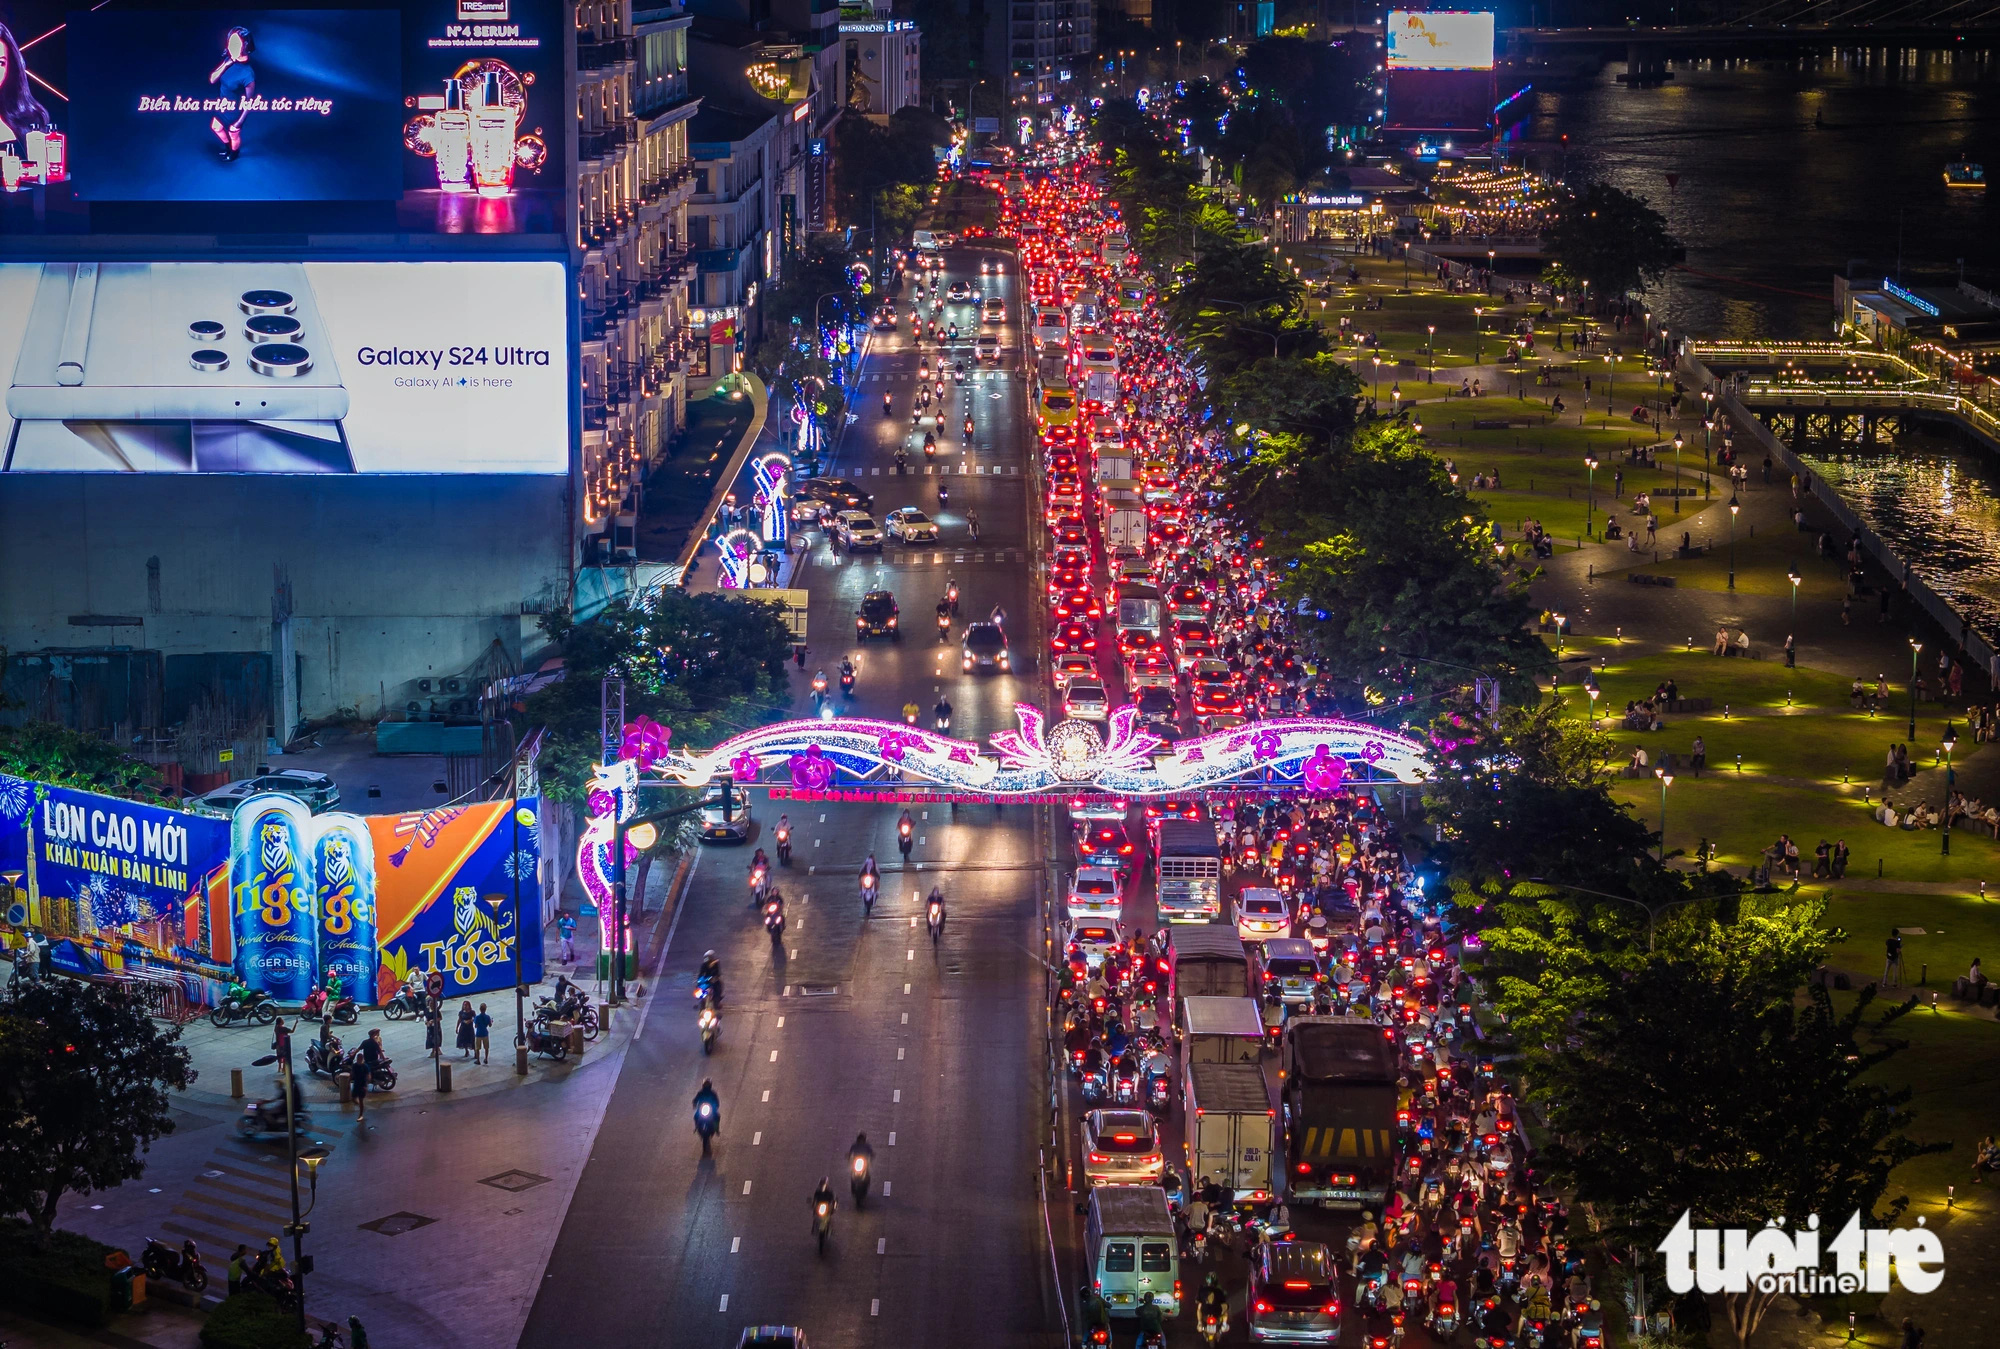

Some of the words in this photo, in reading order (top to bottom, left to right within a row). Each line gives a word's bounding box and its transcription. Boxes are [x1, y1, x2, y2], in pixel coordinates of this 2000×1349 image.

[461, 2, 505, 11] TRESemmé
[473, 25, 519, 37] SERUM
[138, 95, 171, 111] Biến
[173, 95, 200, 111] hóa
[203, 97, 236, 113] triệu
[239, 94, 268, 111] kiểu
[271, 97, 293, 111] tóc
[294, 97, 332, 115] riêng
[357, 346, 444, 370] Galaxy
[448, 346, 489, 366] S24
[494, 346, 550, 366] Ultra
[394, 377, 440, 389] Galaxy
[442, 377, 454, 387] AI
[469, 377, 480, 387] is
[482, 376, 513, 387] here
[843, 788, 875, 802] NĂM
[1027, 792, 1061, 804] NAM
[43, 800, 86, 843] LON
[91, 809, 137, 854] CAO
[142, 816, 188, 865] MỚI
[45, 842, 78, 867] KHAI
[81, 850, 119, 876] XUÂN
[122, 854, 151, 884] BẢN
[154, 862, 188, 892] LĨNH
[318, 884, 375, 935] iger
[237, 931, 270, 947] World
[244, 958, 281, 971] LAGER
[285, 958, 311, 970] BEER
[419, 930, 516, 986] Tiger
[322, 963, 343, 973] GER
[346, 963, 370, 974] BEER
